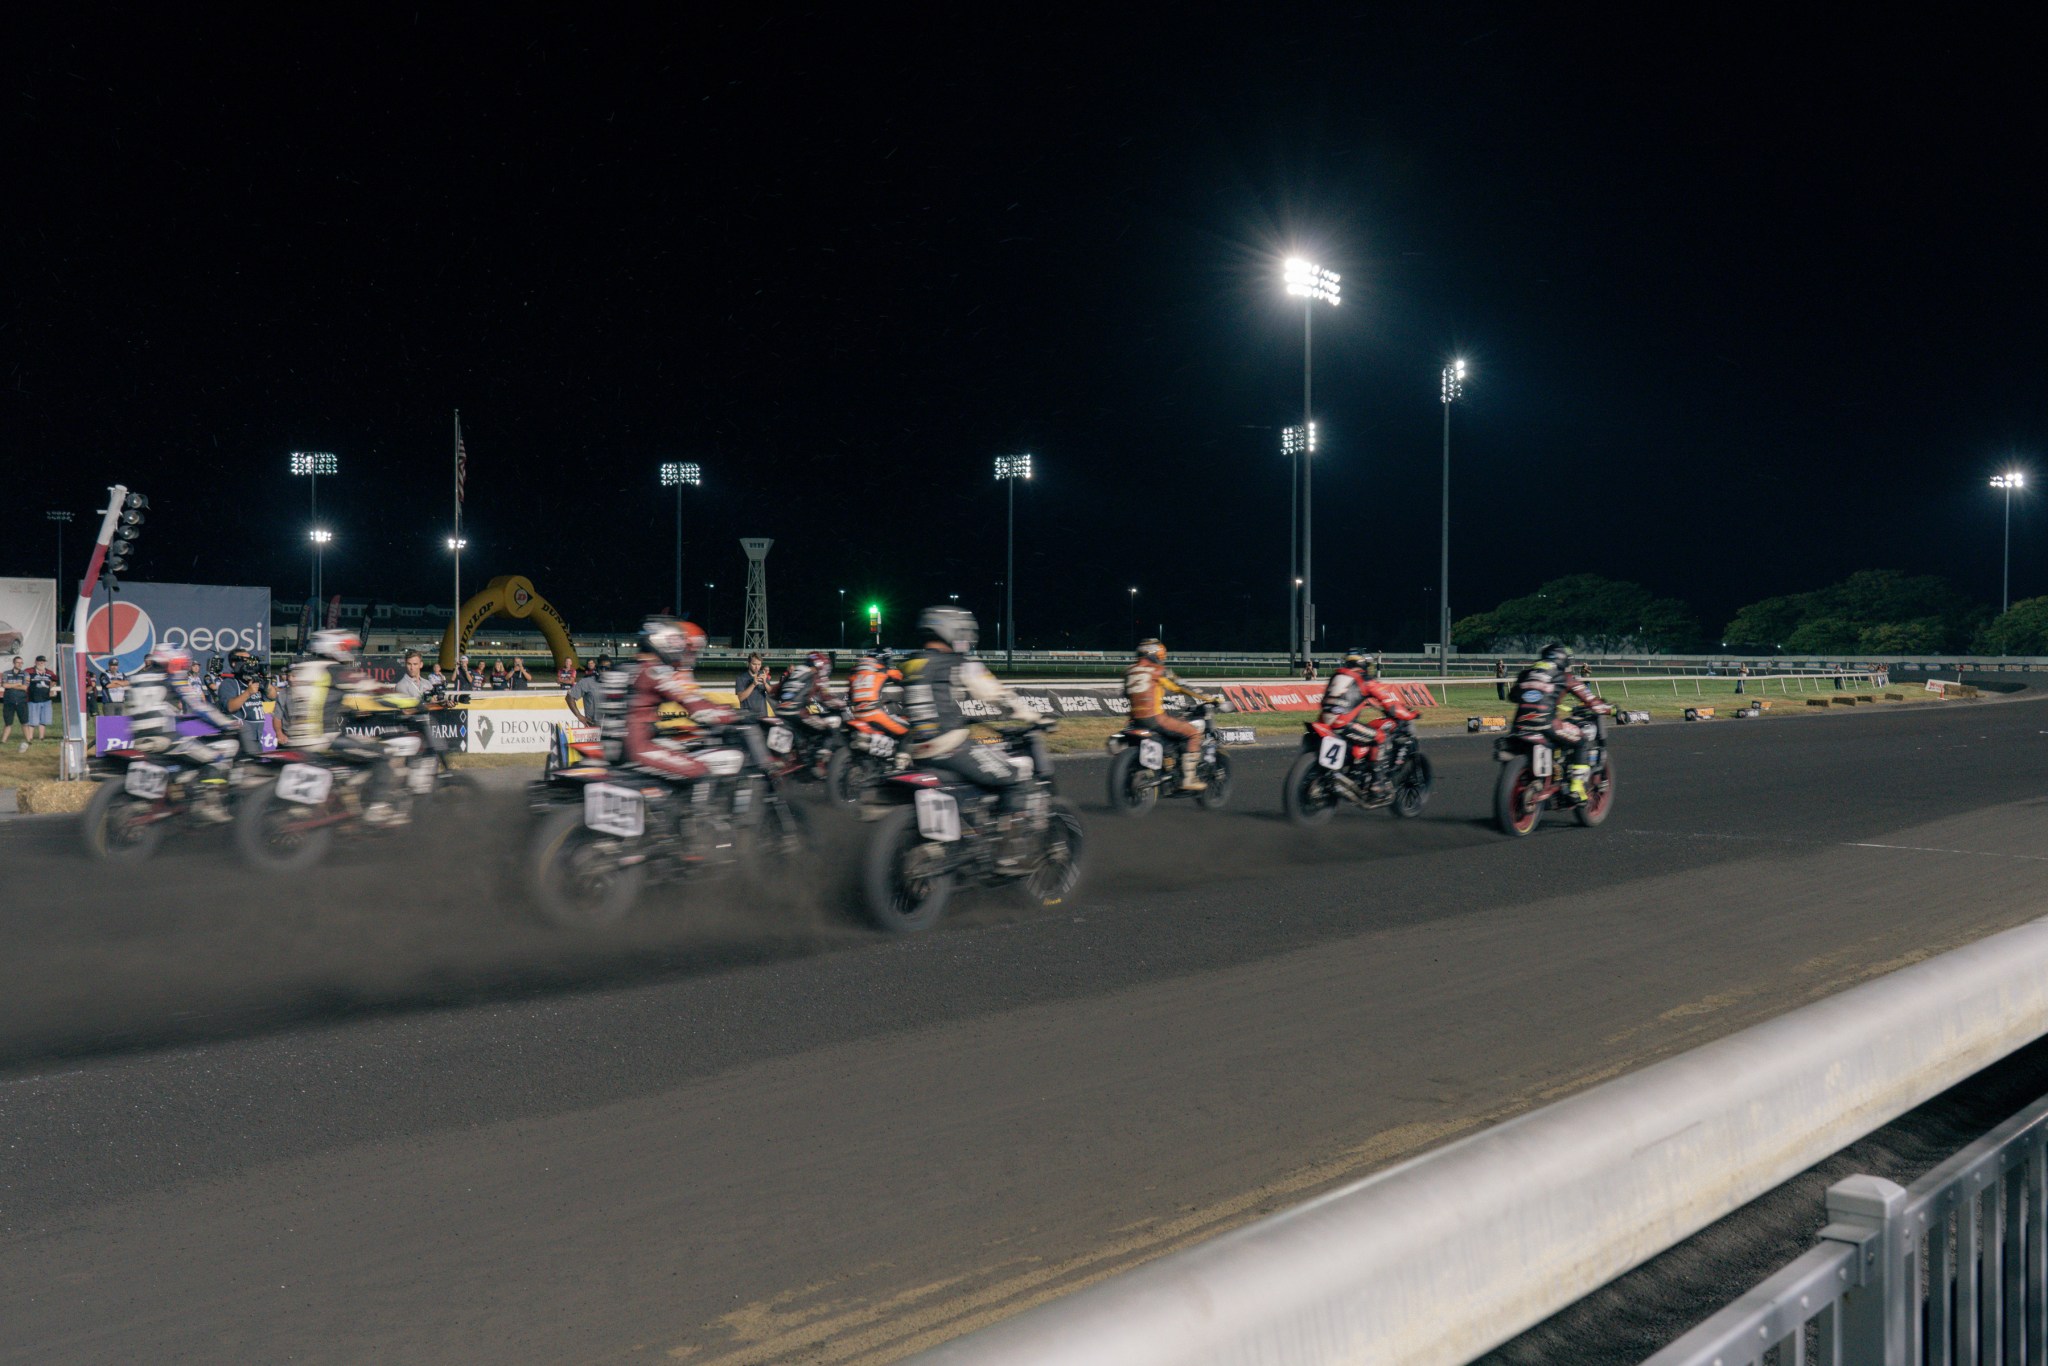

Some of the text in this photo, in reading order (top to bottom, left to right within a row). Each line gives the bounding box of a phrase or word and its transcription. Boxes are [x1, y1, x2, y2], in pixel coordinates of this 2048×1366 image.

[459, 601, 494, 653] DUNLOP
[163, 622, 262, 655] pepsi
[1269, 693, 1302, 705] MOTUL
[431, 724, 458, 738] FARM
[501, 720, 528, 734] DEO
[501, 736, 535, 744] LAZARUS
[1325, 743, 1340, 765] 4
